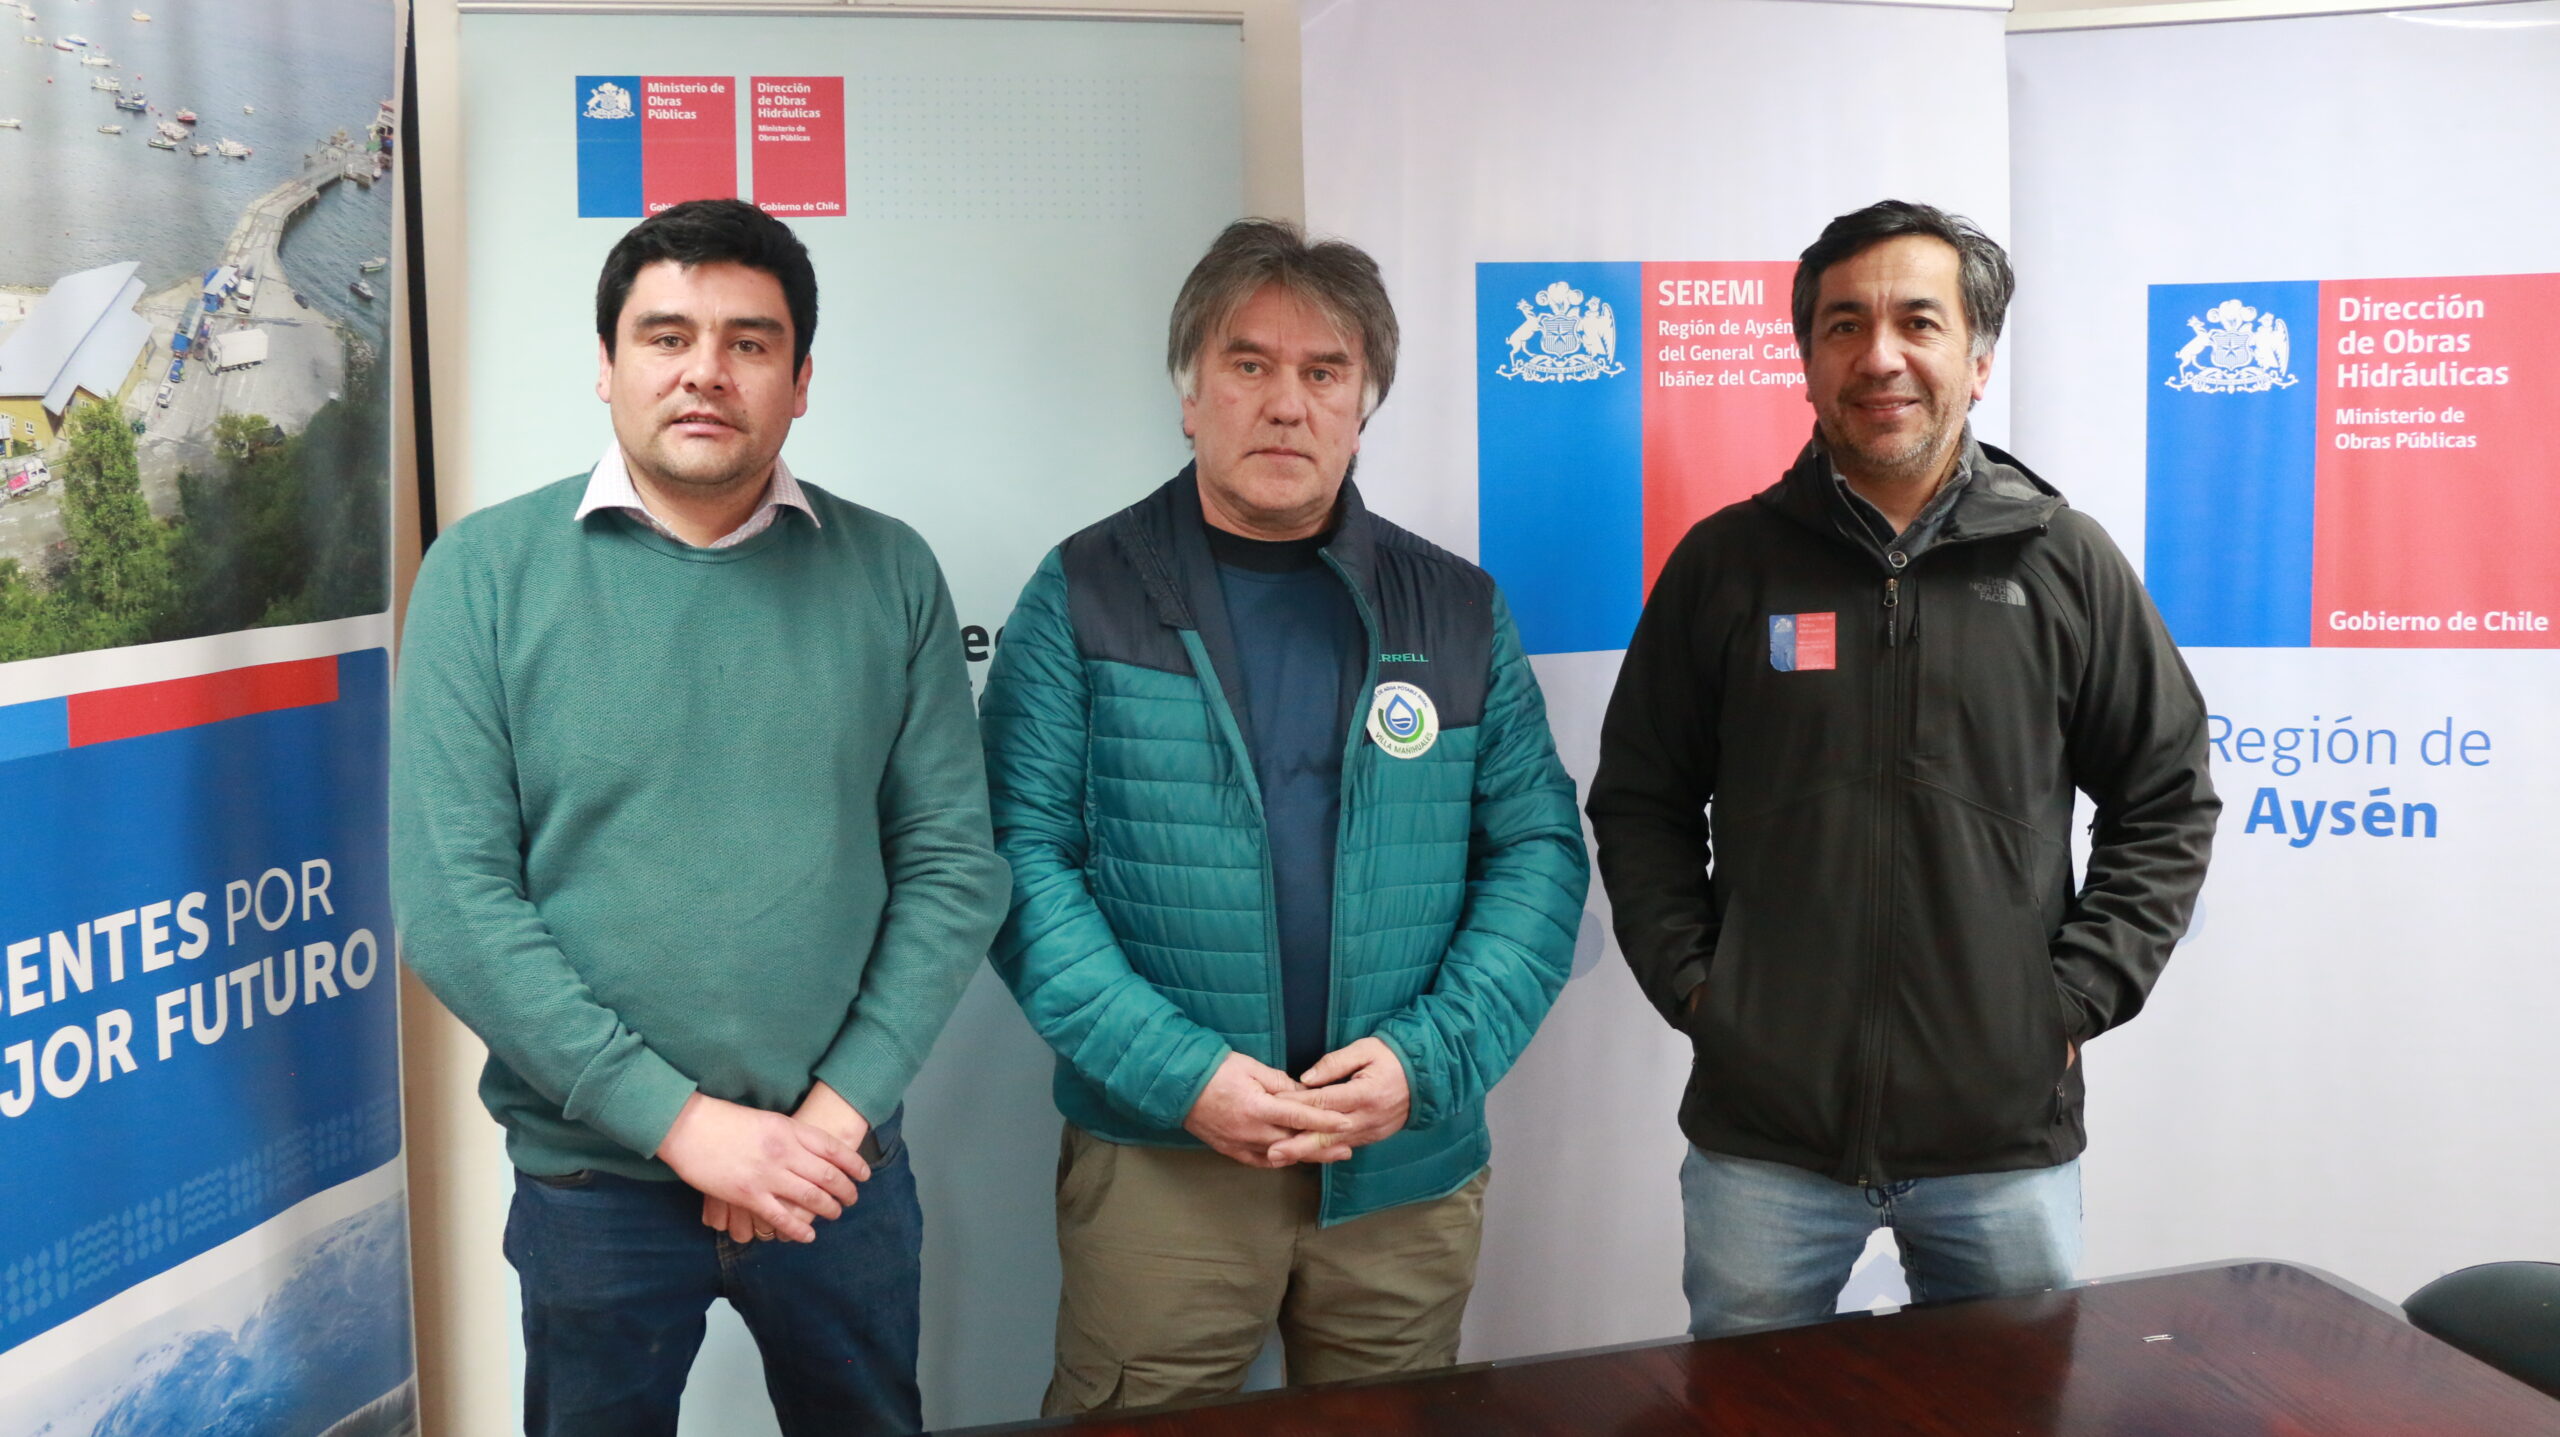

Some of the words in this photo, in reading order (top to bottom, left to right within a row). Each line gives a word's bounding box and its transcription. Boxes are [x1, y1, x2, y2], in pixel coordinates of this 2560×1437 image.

[648, 83, 708, 93] Ministerio
[710, 83, 725, 93] de
[757, 82, 811, 93] Dirección
[648, 96, 682, 106] Obras
[758, 96, 772, 105] de
[774, 95, 807, 105] Obras
[648, 109, 697, 119] Públicas
[758, 108, 821, 118] Hidráulicas
[759, 202, 801, 211] Gobierno
[803, 202, 814, 210] de
[816, 201, 840, 210] Chile
[1658, 279, 1764, 306] SEREMI
[2338, 293, 2485, 322] Dirección
[1658, 319, 1715, 340] Región
[1719, 319, 1740, 335] de
[1744, 318, 1794, 339] Aysén
[2338, 330, 2375, 355] de
[2383, 328, 2471, 354] Obras
[1658, 345, 1686, 361] del
[1690, 344, 1755, 361] General
[1763, 343, 1801, 360] Carl
[1659, 370, 1714, 387] Ibáñez
[1718, 369, 1745, 386] del
[1749, 369, 1806, 388] Campo
[2337, 361, 2510, 388] Hidráulicas
[2336, 406, 2436, 425] Ministerio
[2440, 406, 2466, 424] de
[2335, 432, 2391, 449] Obras
[2395, 430, 2477, 449] Públicas
[1980, 592, 2007, 603] FACE
[2329, 610, 2441, 632] Gobierno
[2447, 611, 2477, 632] de
[2484, 610, 2549, 632] Chile
[1379, 653, 1430, 663] RRELL
[2207, 714, 2397, 777] Región
[2420, 716, 2491, 767] de
[2244, 786, 2437, 848] Aysén
[0, 891, 210, 1017] ENTES
[226, 858, 335, 947] POR
[156, 928, 378, 1062] FUTURO
